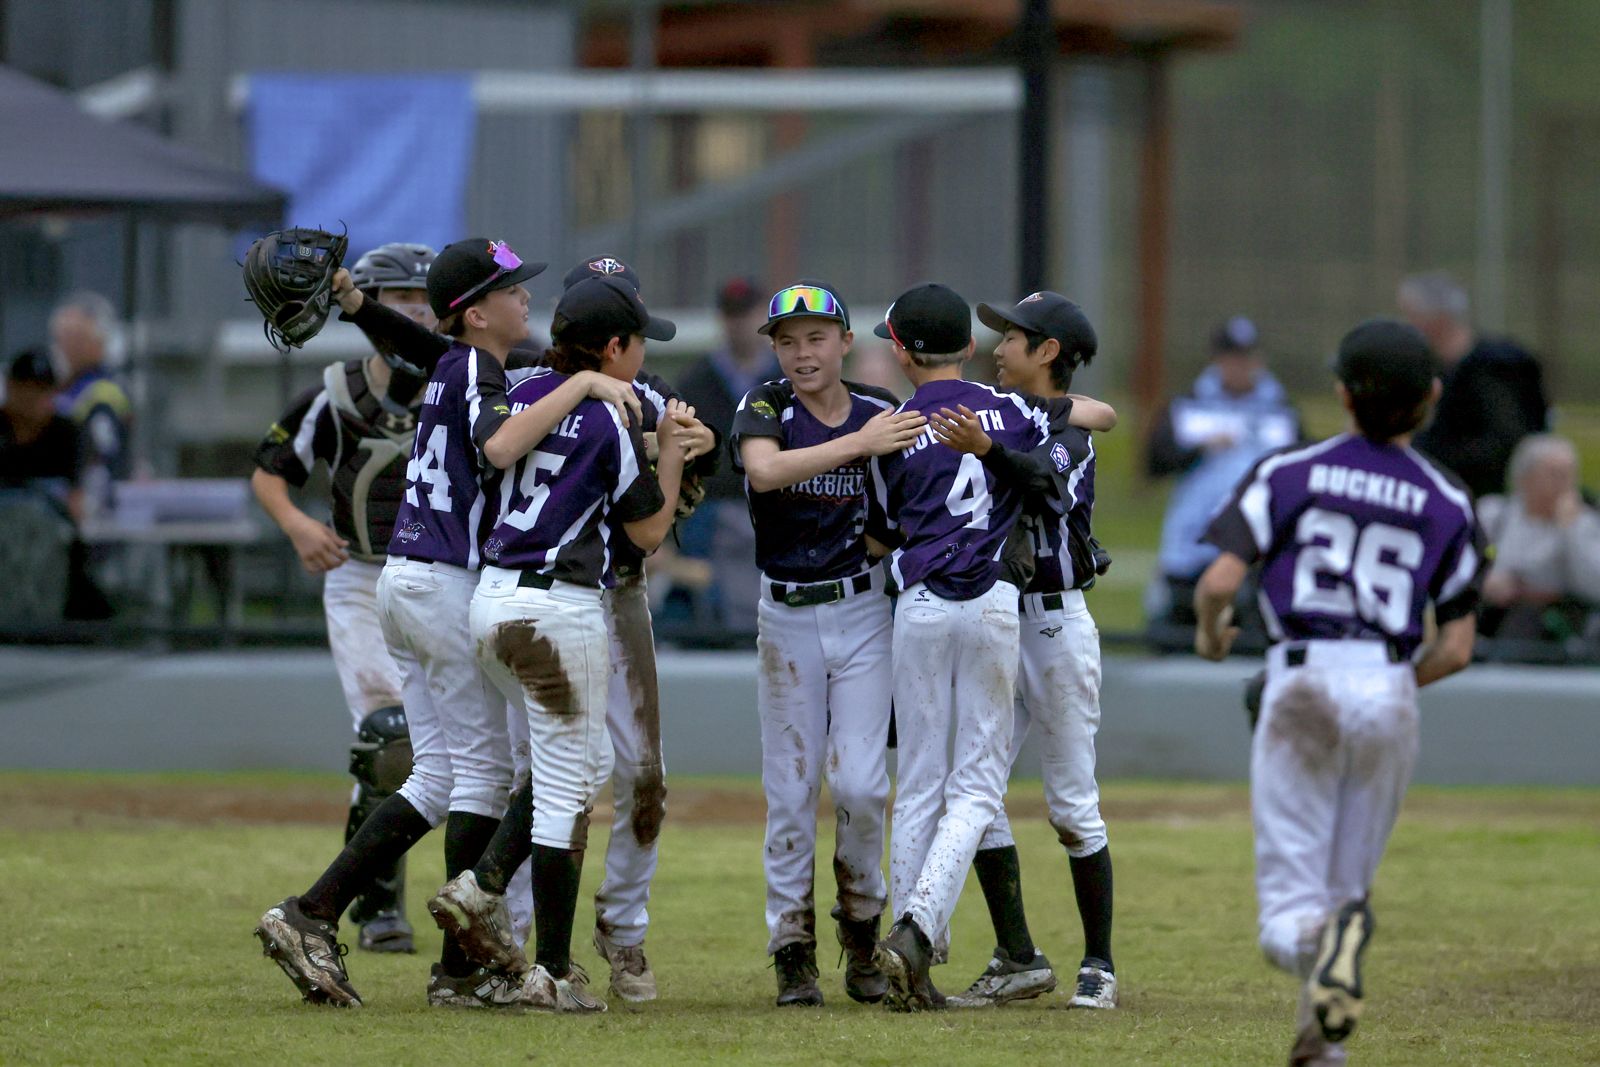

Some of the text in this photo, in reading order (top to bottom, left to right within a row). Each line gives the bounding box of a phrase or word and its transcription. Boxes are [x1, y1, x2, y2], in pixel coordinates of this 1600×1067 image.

[493, 450, 567, 532] 15
[945, 453, 994, 531] 4
[1308, 464, 1427, 514] BUCKLEY
[1291, 507, 1424, 635] 26
